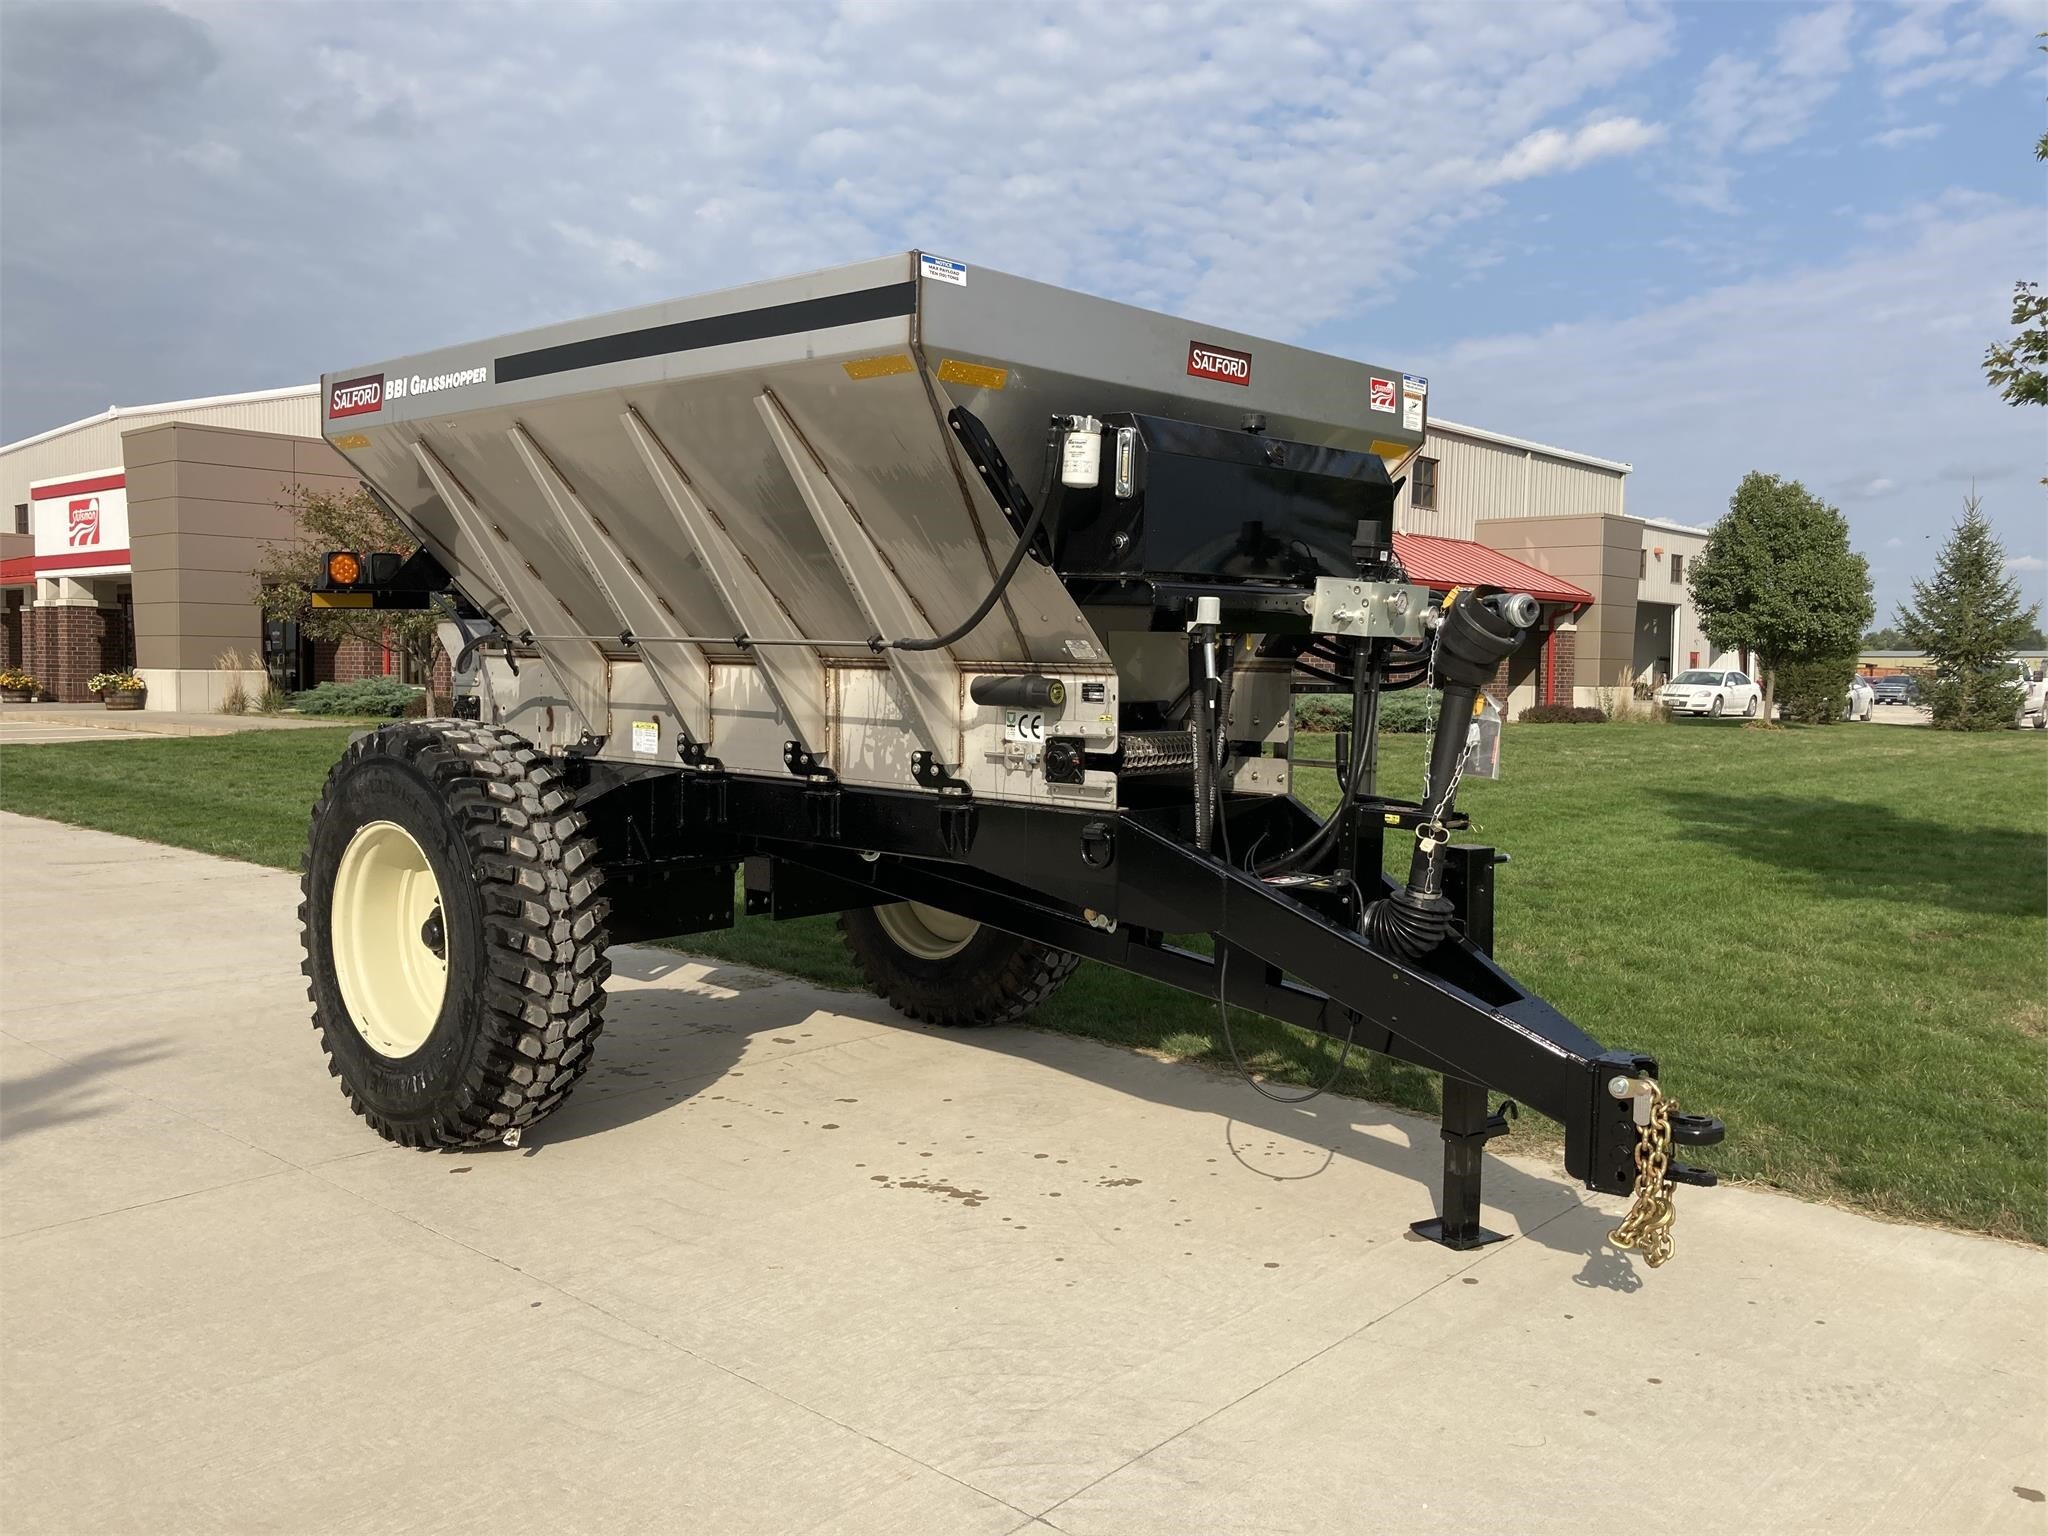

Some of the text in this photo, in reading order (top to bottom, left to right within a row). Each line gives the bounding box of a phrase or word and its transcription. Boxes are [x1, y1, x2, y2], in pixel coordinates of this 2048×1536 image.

[939, 267, 960, 276] PAYLOAD
[1192, 349, 1248, 378] SALFORD
[333, 383, 380, 410] SALFORD
[385, 367, 487, 400] BBI GRASSHOPPER
[1018, 714, 1041, 739] CE
